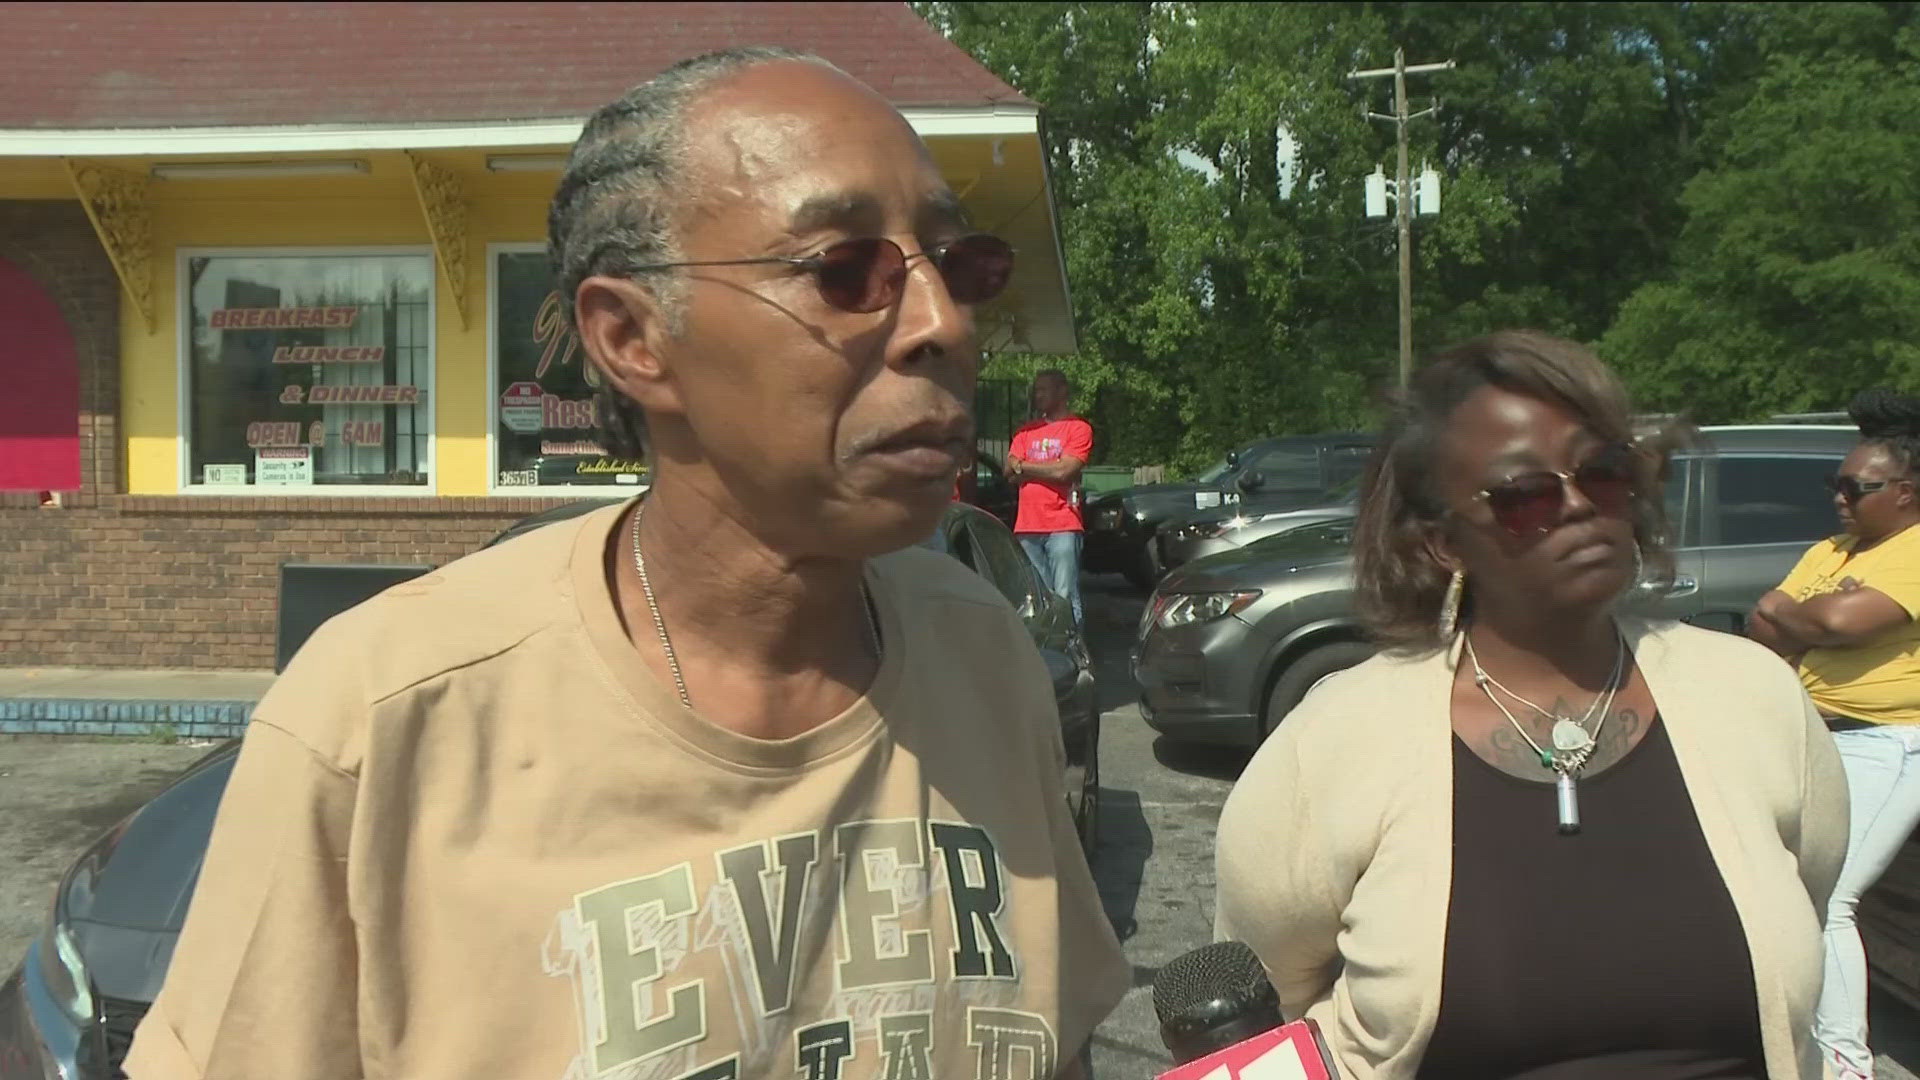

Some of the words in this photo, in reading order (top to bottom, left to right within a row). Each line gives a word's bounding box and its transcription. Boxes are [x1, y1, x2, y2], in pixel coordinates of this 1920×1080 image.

[210, 306, 358, 329] BREAKFAST
[272, 347, 384, 363] LUNCH
[279, 385, 305, 404] &
[307, 385, 418, 404] DINNER
[247, 421, 301, 448] OPEN
[308, 420, 325, 447] @
[341, 421, 383, 446] 6AM
[261, 448, 306, 458] WARNING
[262, 461, 287, 470] Security
[576, 457, 626, 474] Established
[262, 472, 287, 480] Cameras
[1223, 493, 1240, 505] K-9
[573, 818, 1018, 1076] EVER
